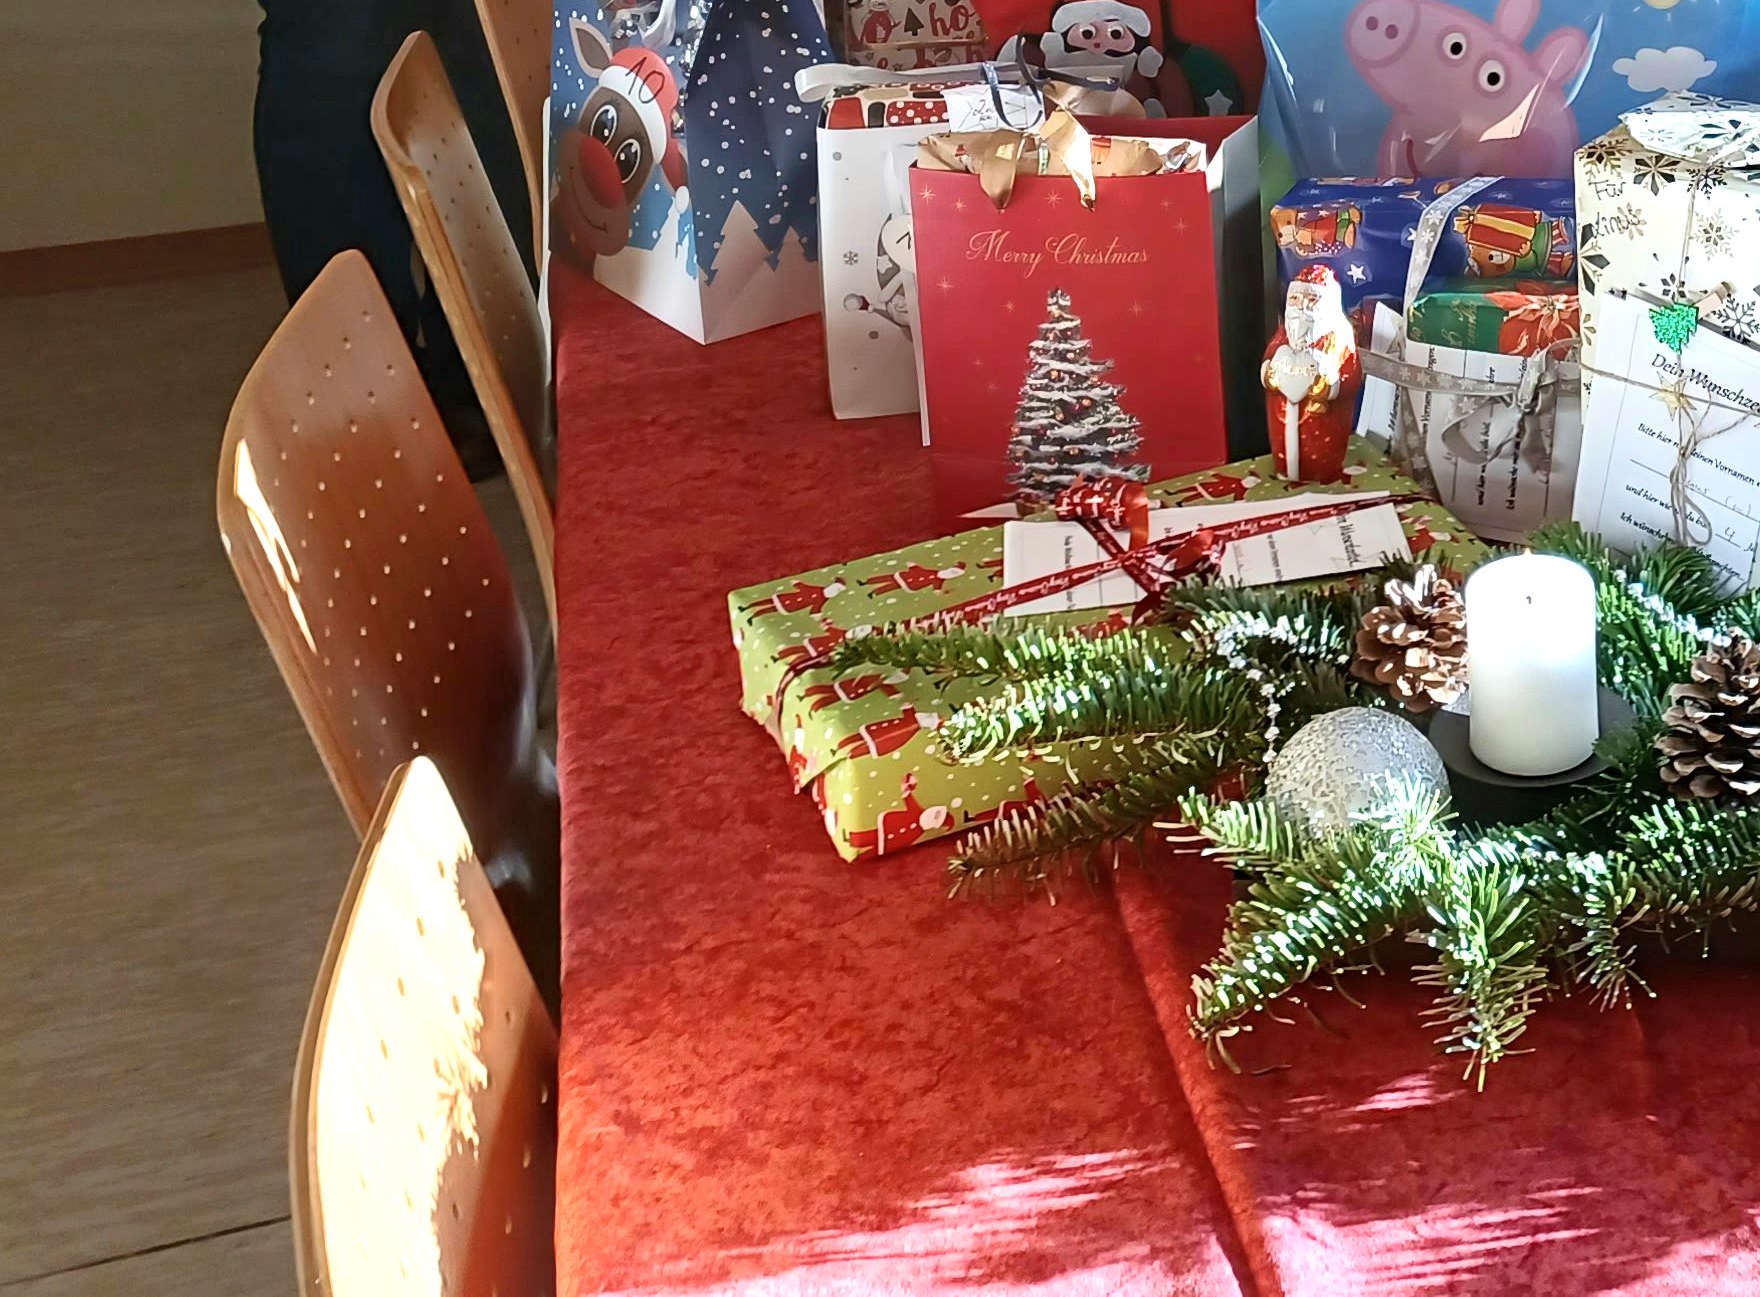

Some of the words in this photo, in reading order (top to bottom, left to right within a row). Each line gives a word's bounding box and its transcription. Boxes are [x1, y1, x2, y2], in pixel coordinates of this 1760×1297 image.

[928, 2, 976, 37] ho
[625, 56, 665, 104] 10
[1588, 179, 1627, 201] Für
[965, 229, 1044, 279] Merry
[1045, 233, 1148, 265] Christmas
[1651, 353, 1684, 378] Dein
[1638, 423, 1656, 437] Bitte
[1656, 431, 1672, 444] hier
[1715, 458, 1755, 486] Vornamen
[1625, 484, 1644, 497] und
[1643, 490, 1658, 503] hier
[1620, 512, 1632, 524] Ich
